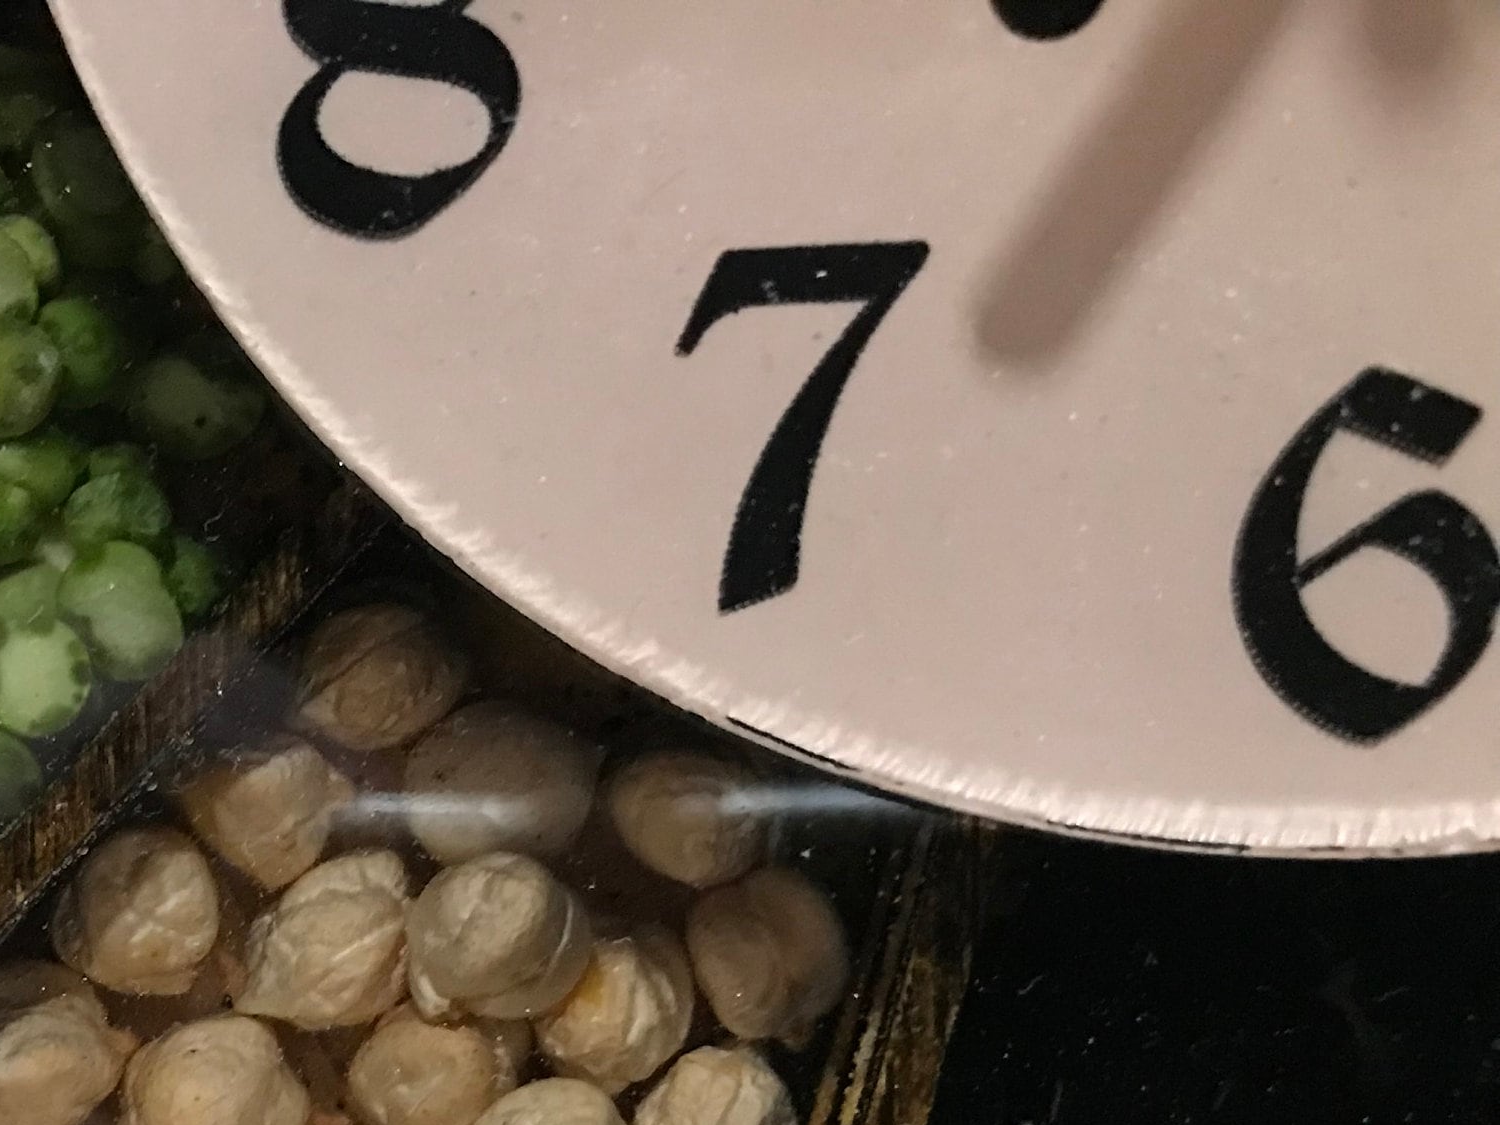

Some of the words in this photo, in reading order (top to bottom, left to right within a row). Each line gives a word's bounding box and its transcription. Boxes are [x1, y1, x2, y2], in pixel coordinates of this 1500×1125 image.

[275, 0, 522, 242] 8
[674, 240, 931, 614] 7
[1231, 365, 1500, 746] 6
